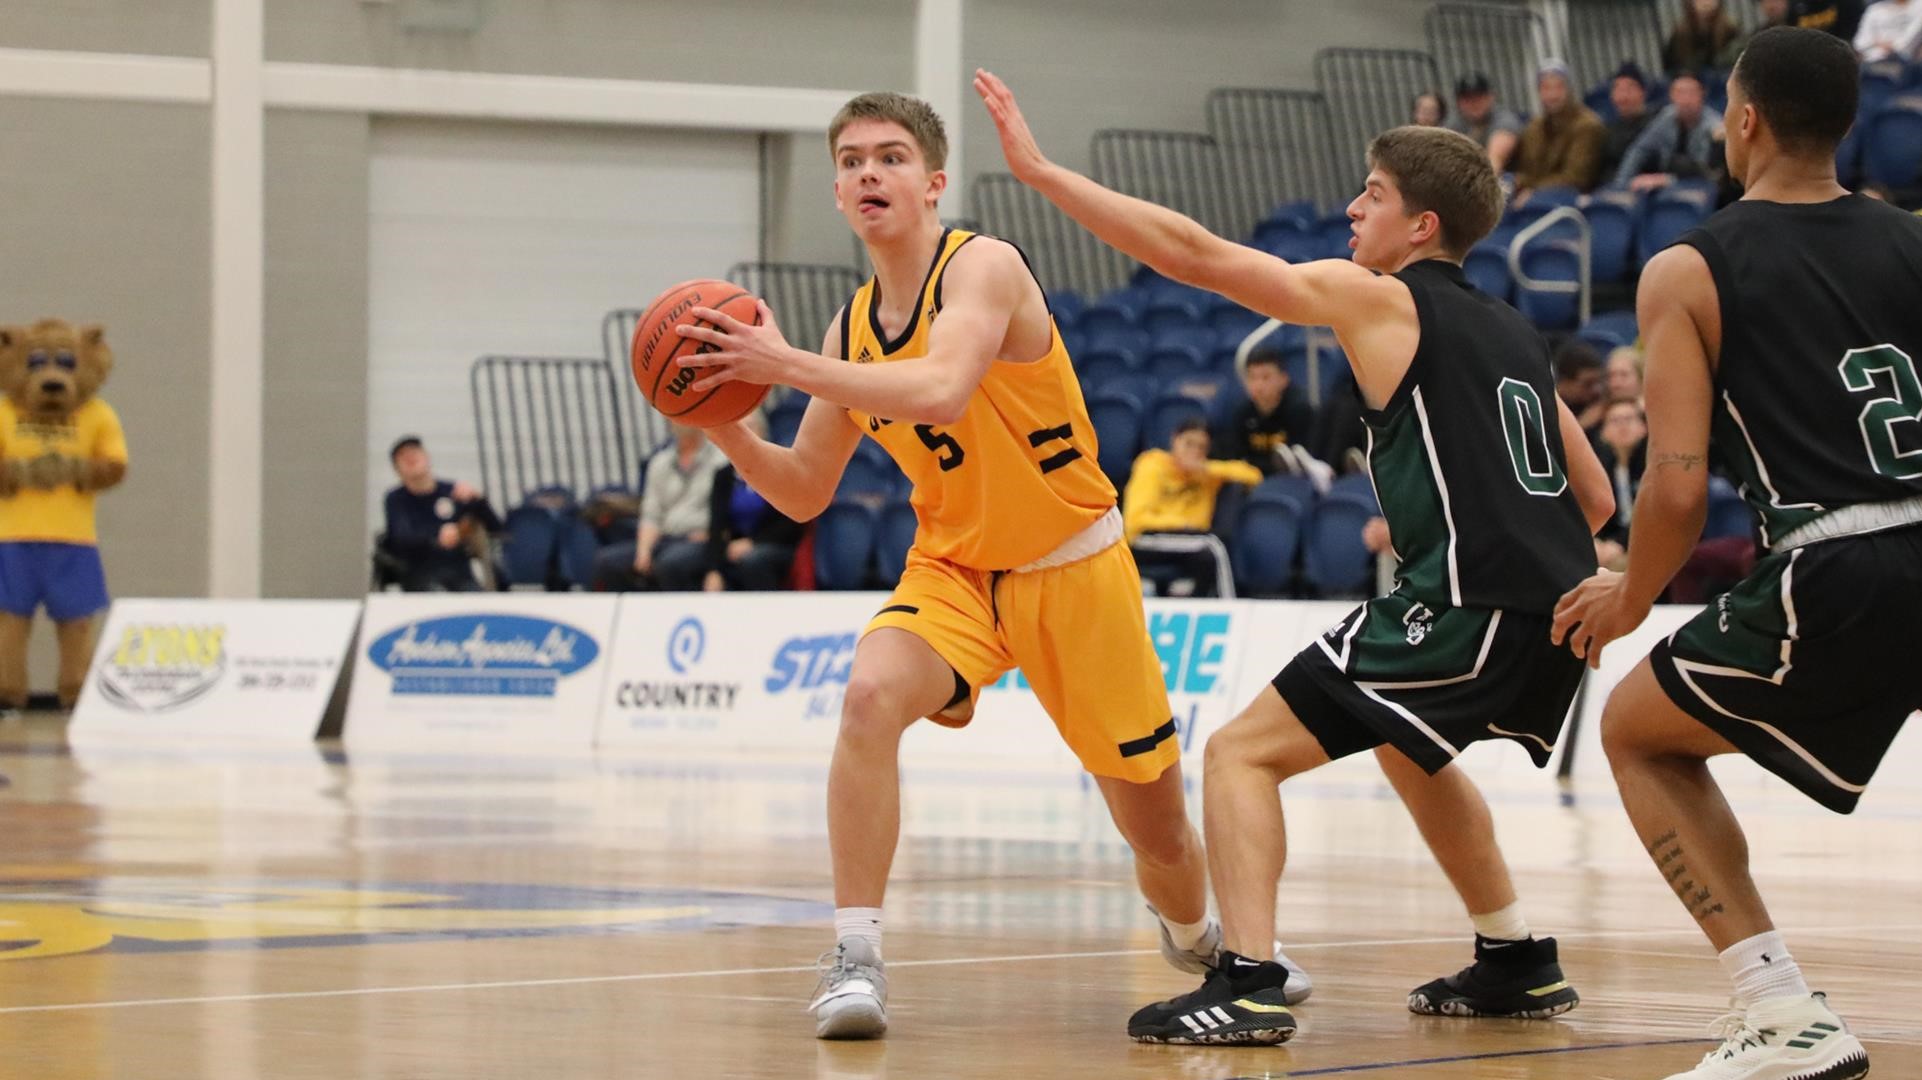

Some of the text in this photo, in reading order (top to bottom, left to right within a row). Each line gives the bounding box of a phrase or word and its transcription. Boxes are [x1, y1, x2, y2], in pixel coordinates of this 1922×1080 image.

[642, 291, 702, 372] EVOLUTION
[913, 423, 965, 472] 5
[1497, 376, 1568, 497] 0
[1837, 342, 1922, 480] 2
[616, 682, 740, 709] COUNTRY
